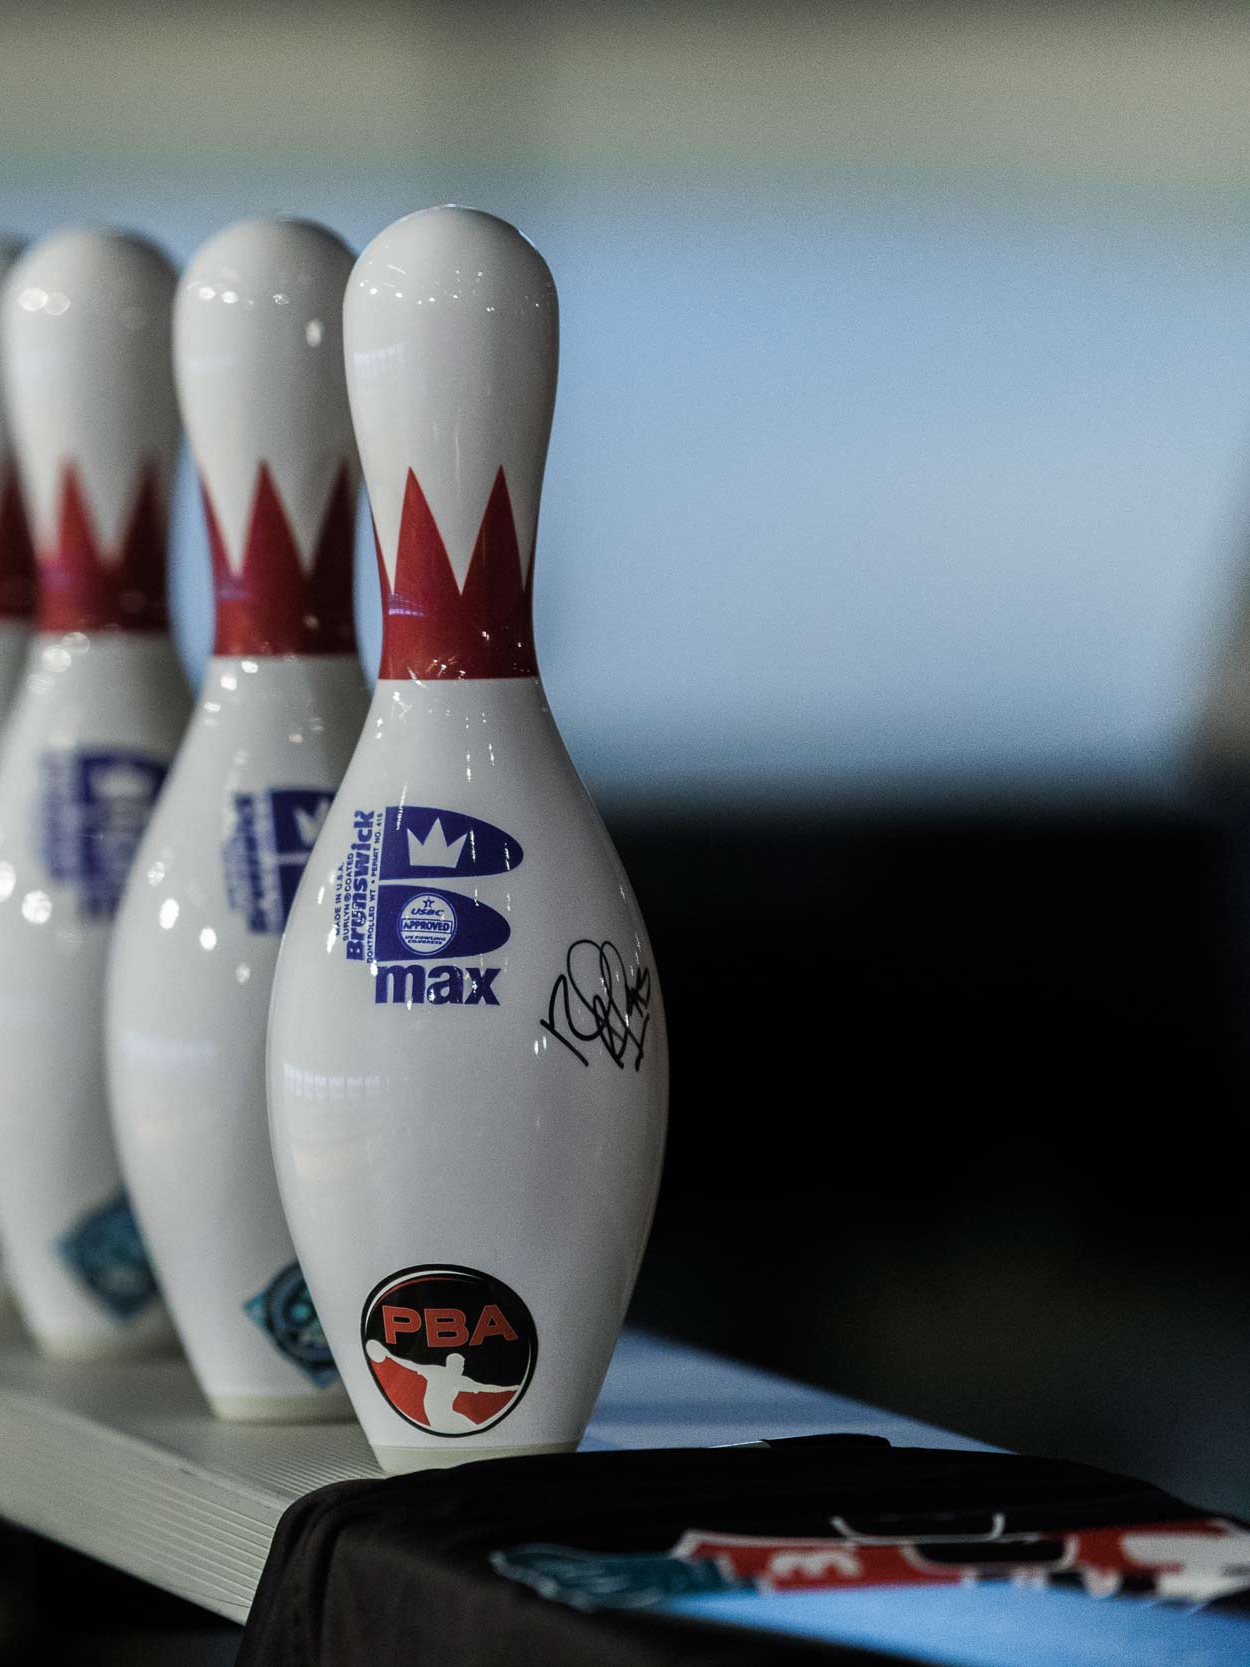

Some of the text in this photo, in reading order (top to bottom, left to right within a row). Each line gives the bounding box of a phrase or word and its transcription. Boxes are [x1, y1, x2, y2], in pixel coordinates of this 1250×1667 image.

[371, 848, 379, 876] PERMIT
[335, 891, 342, 904] IN
[346, 810, 375, 960] Brunswick
[370, 889, 376, 902] WT
[404, 920, 449, 931] APPROVED
[411, 908, 445, 916] USBC
[367, 906, 375, 963] CONTROLLED
[375, 964, 502, 1006] max
[382, 1304, 518, 1347] PBA
